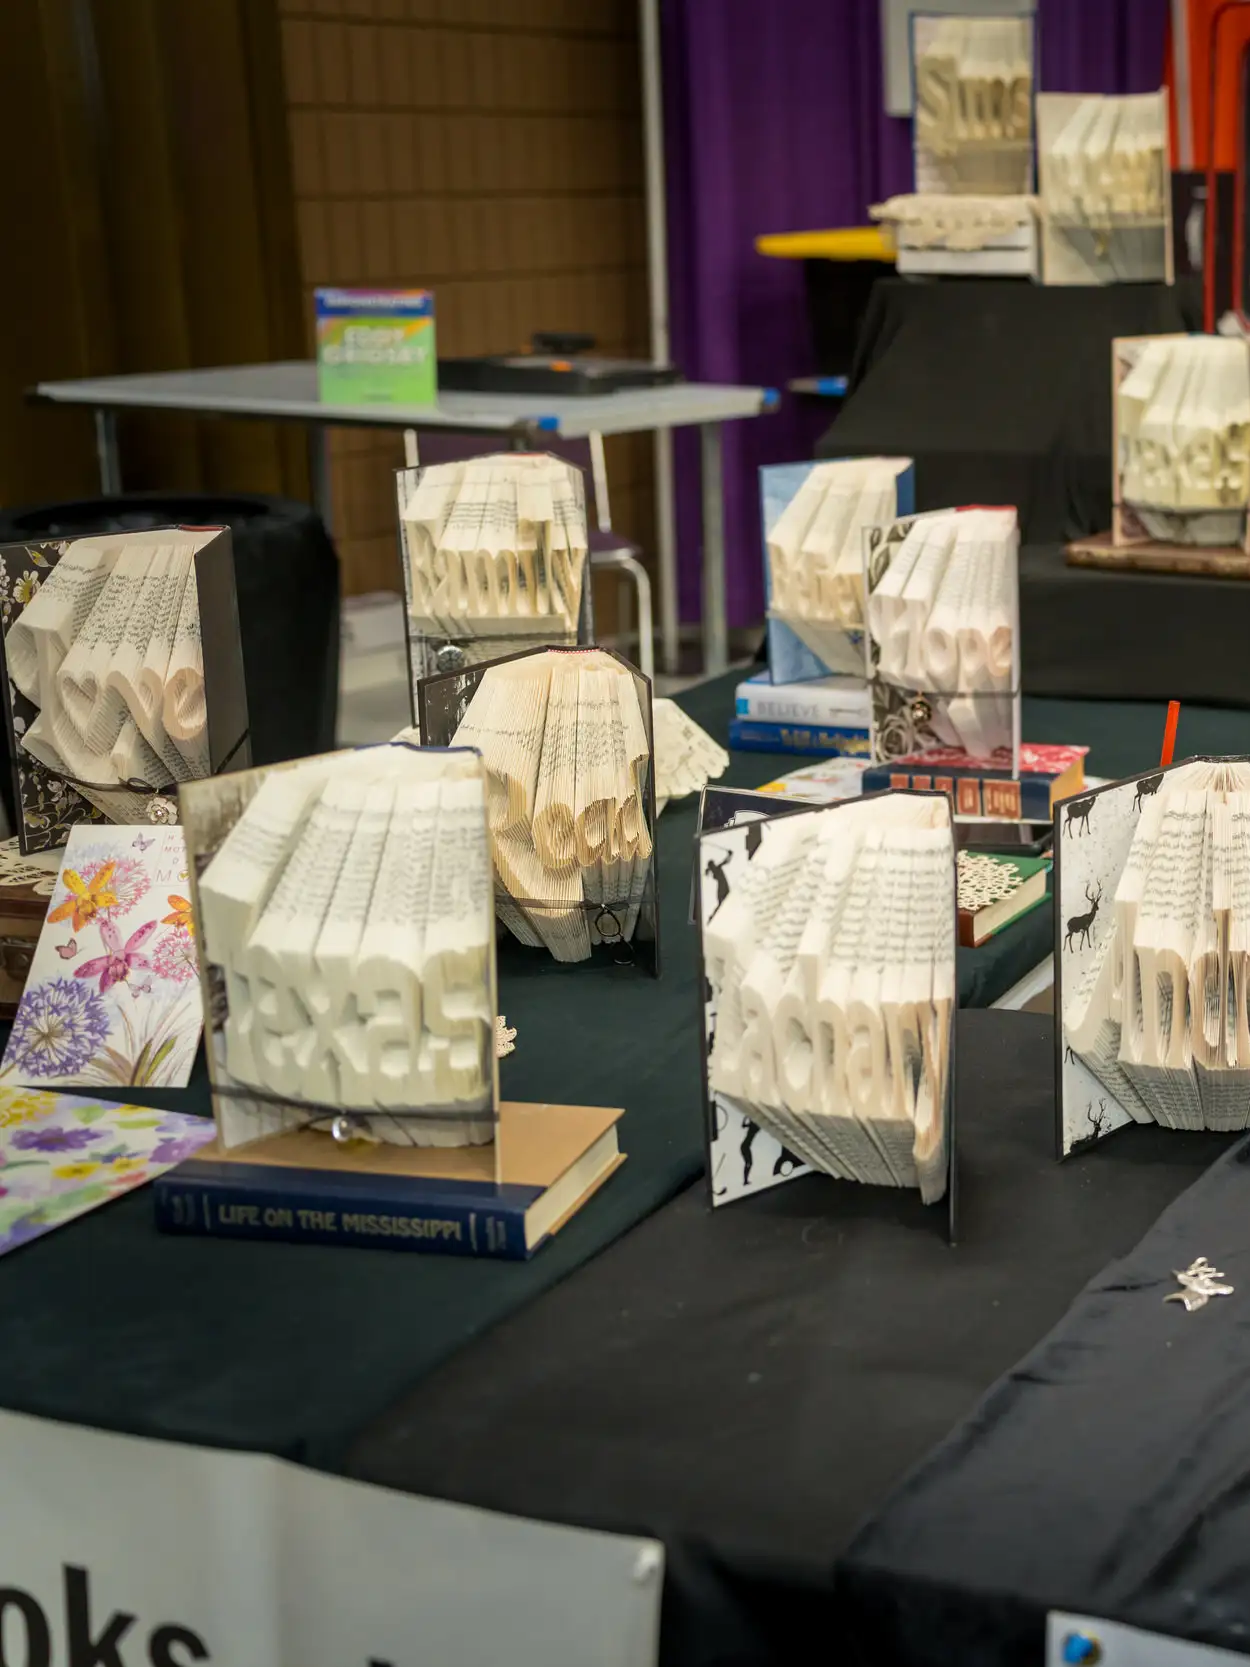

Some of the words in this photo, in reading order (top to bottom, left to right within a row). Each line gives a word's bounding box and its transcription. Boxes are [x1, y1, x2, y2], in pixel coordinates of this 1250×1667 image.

[757, 701, 820, 718] BELIEVE
[218, 1203, 260, 1226] LIFE
[264, 1207, 293, 1228] ON
[297, 1209, 337, 1232] THE
[341, 1213, 462, 1242] MISSISSIPPI
